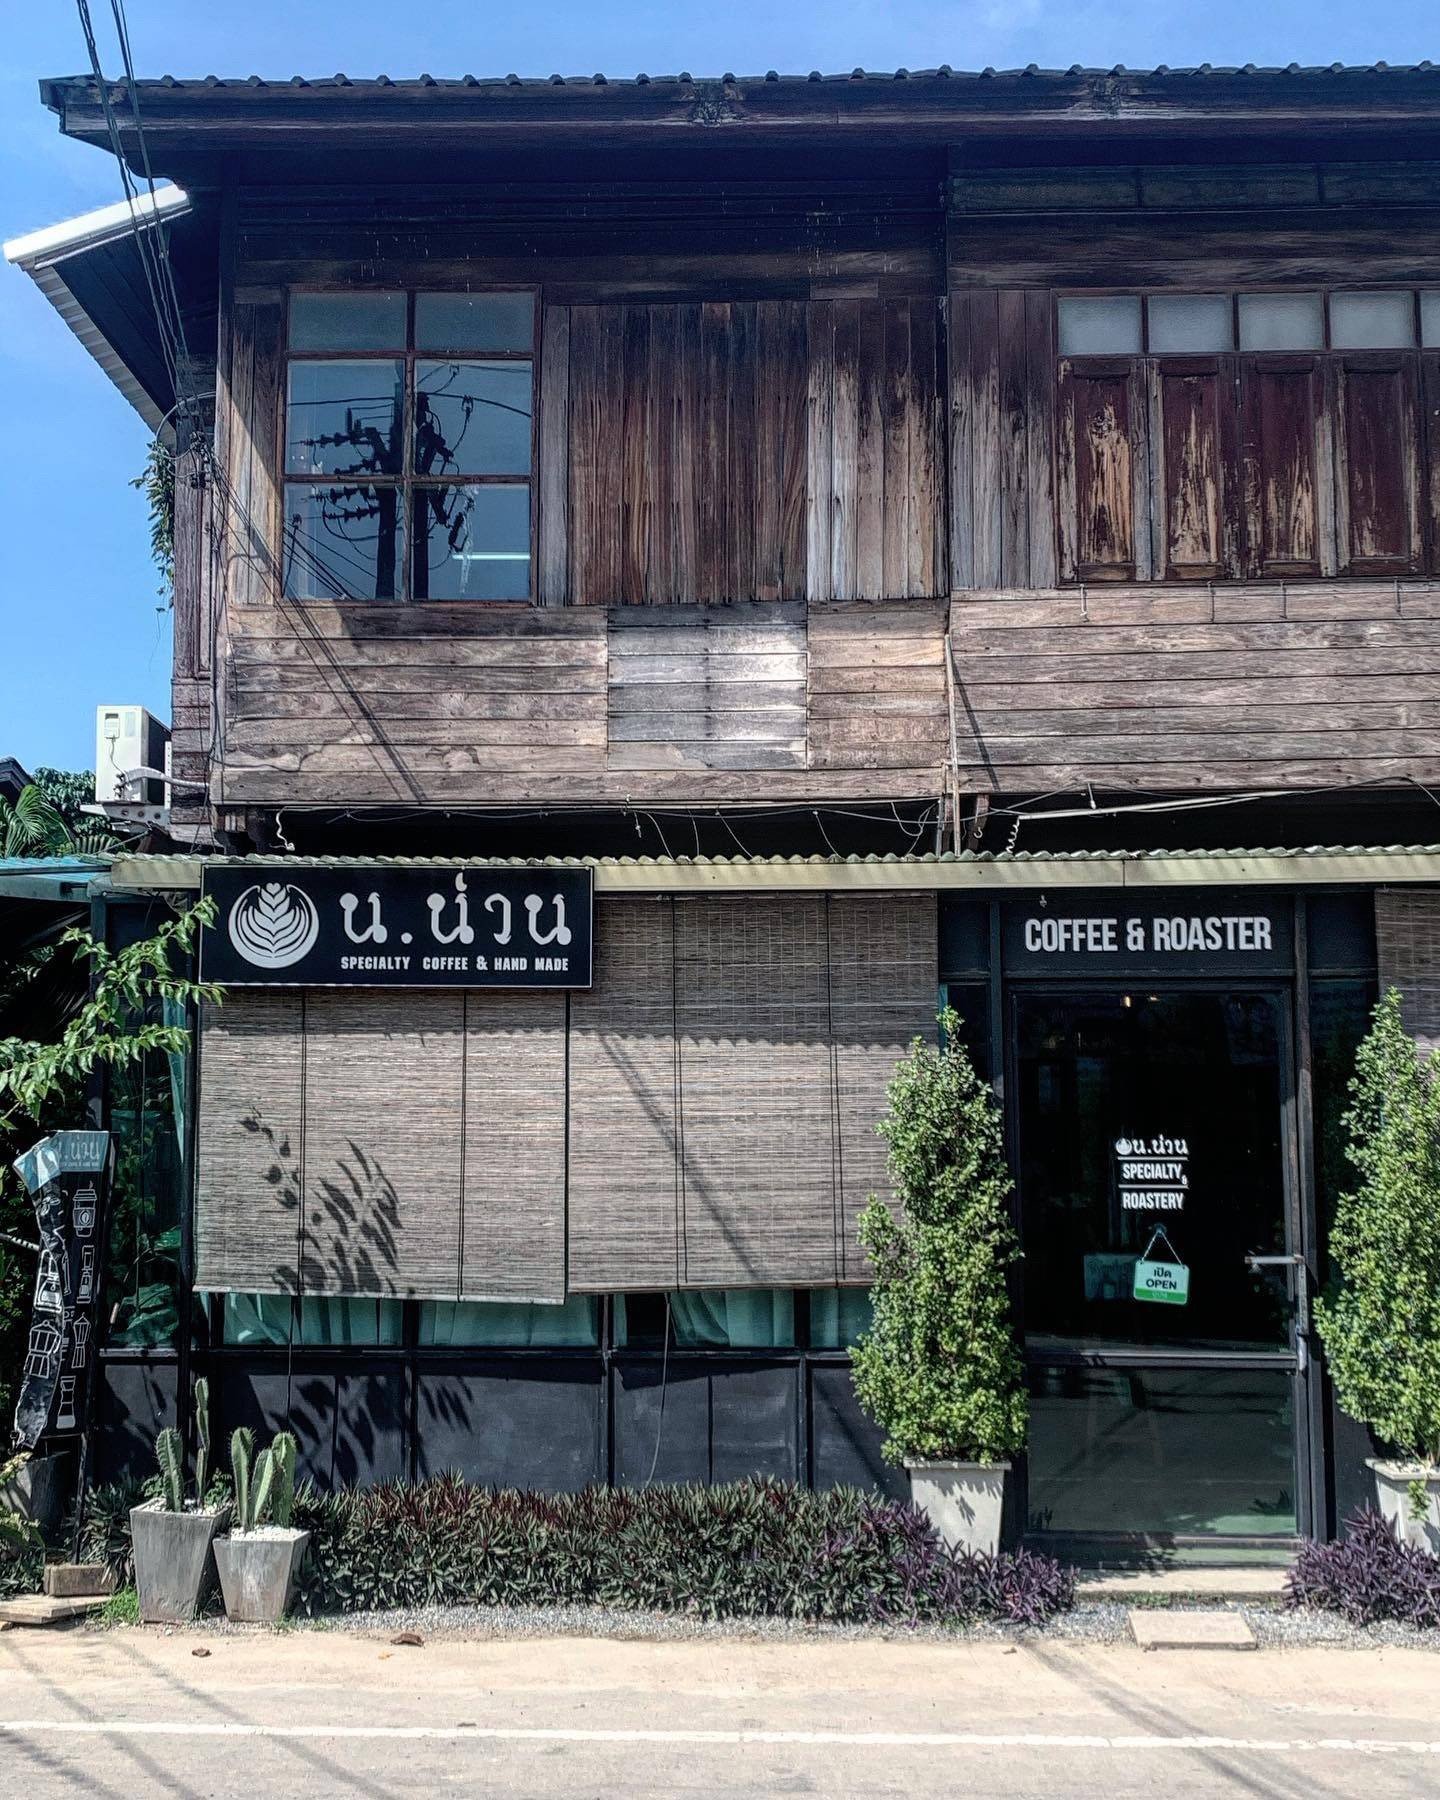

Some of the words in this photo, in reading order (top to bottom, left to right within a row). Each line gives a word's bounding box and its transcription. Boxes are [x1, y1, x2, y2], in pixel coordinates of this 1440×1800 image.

[1025, 918, 1118, 952] COFFEE
[1126, 918, 1146, 952] &
[1153, 916, 1273, 951] ROASTER
[340, 956, 411, 970] SPECIALTY
[422, 956, 469, 971] COFFEE
[476, 955, 489, 971] &
[494, 956, 528, 971] HAND
[534, 957, 569, 971] MADE
[1122, 1162, 1182, 1180] SPECIALTY
[1122, 1191, 1184, 1210] ROASTERY
[1145, 1278, 1177, 1290] OPEN
